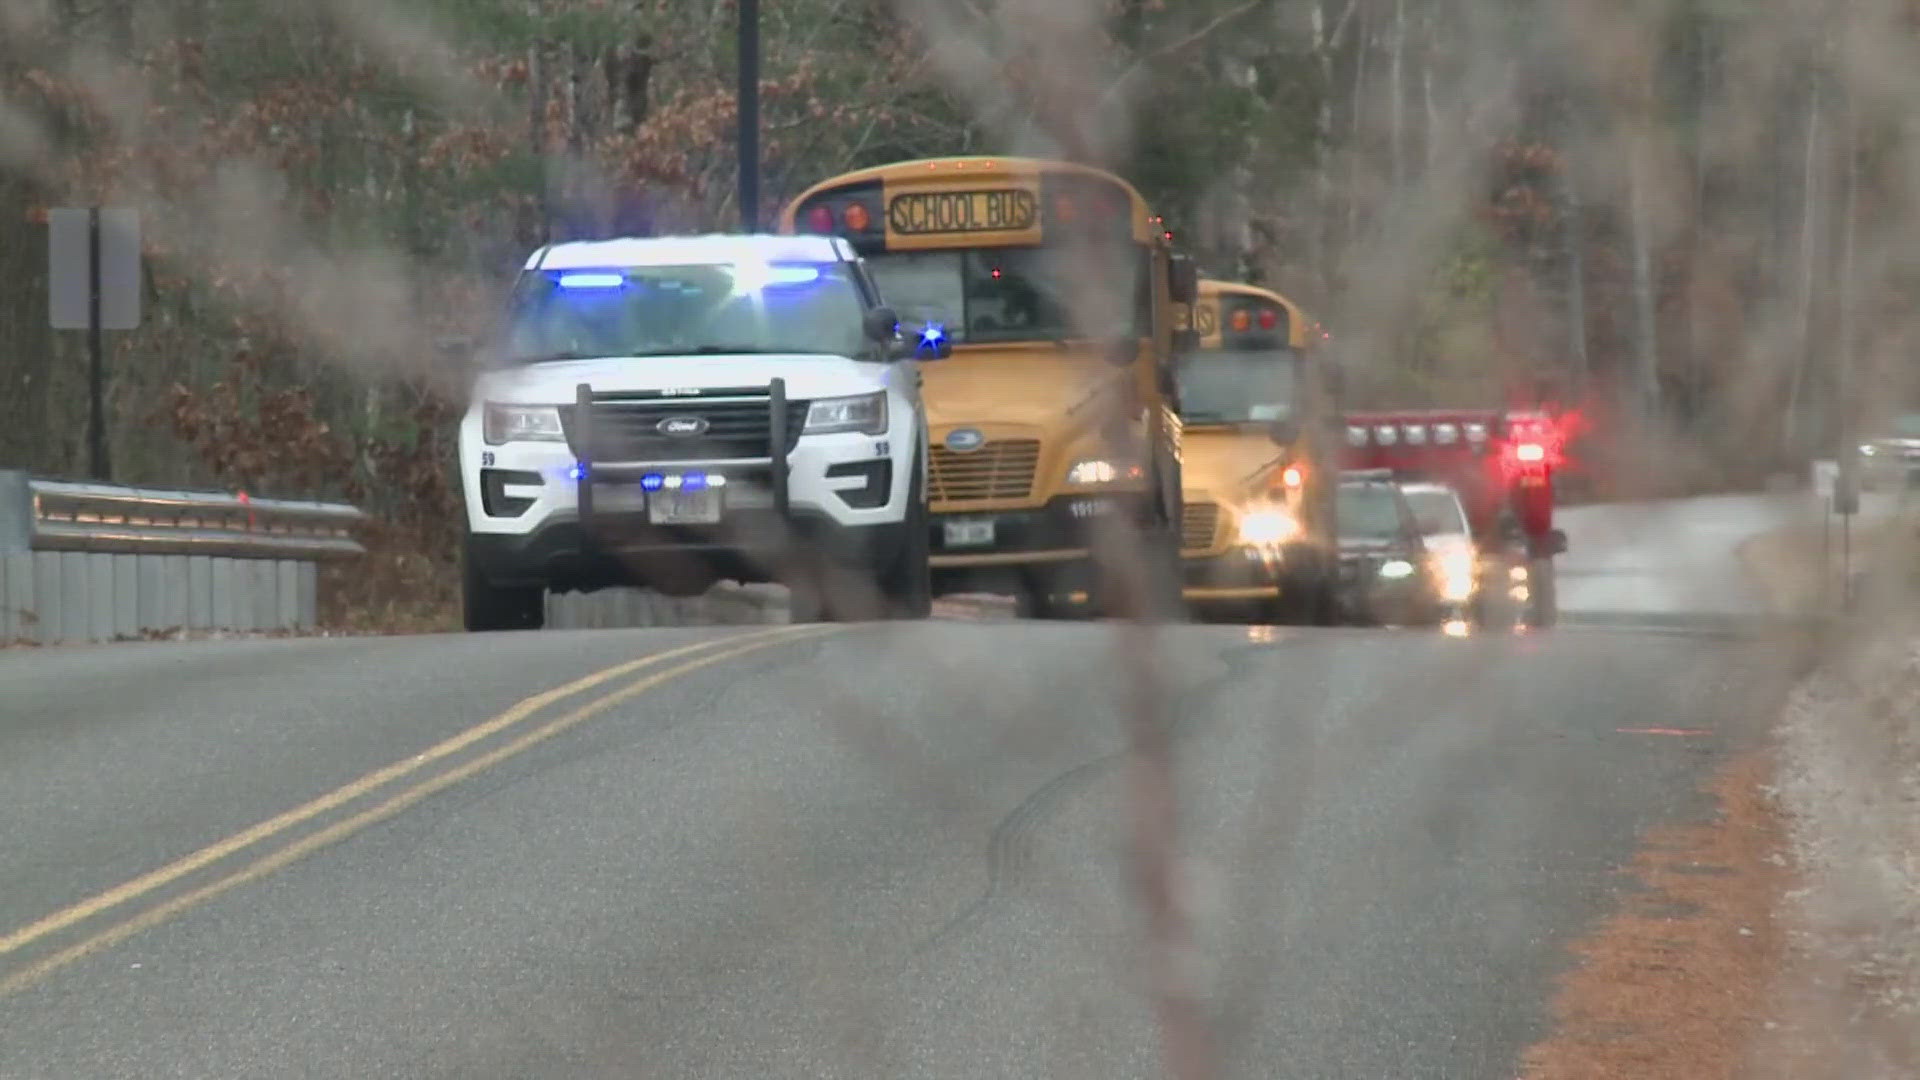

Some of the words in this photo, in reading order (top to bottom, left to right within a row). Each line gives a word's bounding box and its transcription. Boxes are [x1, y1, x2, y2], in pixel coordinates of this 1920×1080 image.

[893, 194, 981, 232] SCHOOL
[988, 190, 1029, 227] BUS
[667, 420, 698, 431] Ford
[482, 451, 495, 466] 59
